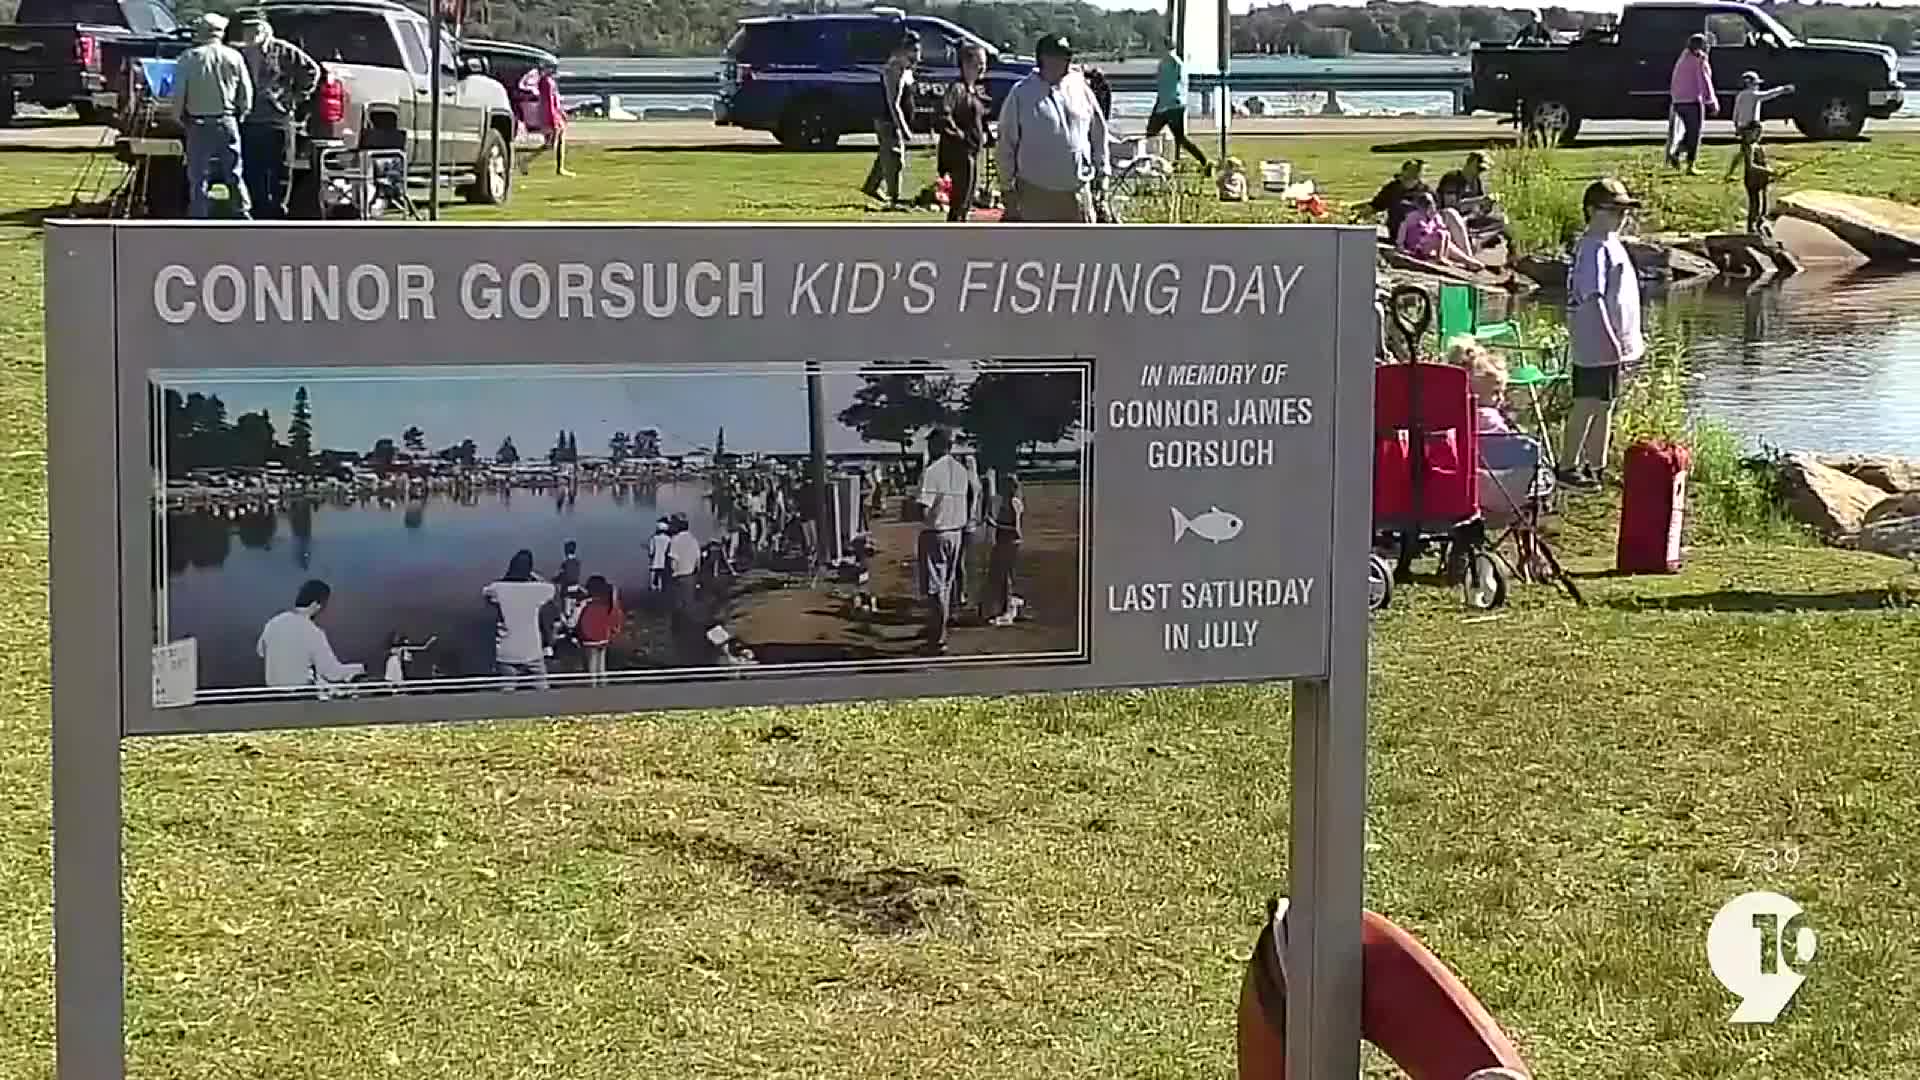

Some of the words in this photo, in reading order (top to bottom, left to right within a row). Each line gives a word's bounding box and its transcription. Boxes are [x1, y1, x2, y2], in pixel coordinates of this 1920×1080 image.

[153, 263, 436, 323] CONNOR
[460, 261, 766, 319] GORSUCH
[788, 261, 938, 316] KID'S
[958, 260, 1182, 314] FISHING
[1199, 263, 1304, 315] DAY
[1140, 364, 1163, 388] IN
[1167, 363, 1257, 386] MEMORY
[1260, 363, 1289, 385] OF
[1109, 399, 1219, 429] CONNOR
[1226, 397, 1313, 426] JAMES
[1148, 439, 1274, 468] GORSUCH
[1108, 582, 1172, 612] LAST
[1181, 577, 1314, 609] SATURDAY
[1163, 622, 1189, 650] IN
[1197, 619, 1260, 649] JULY
